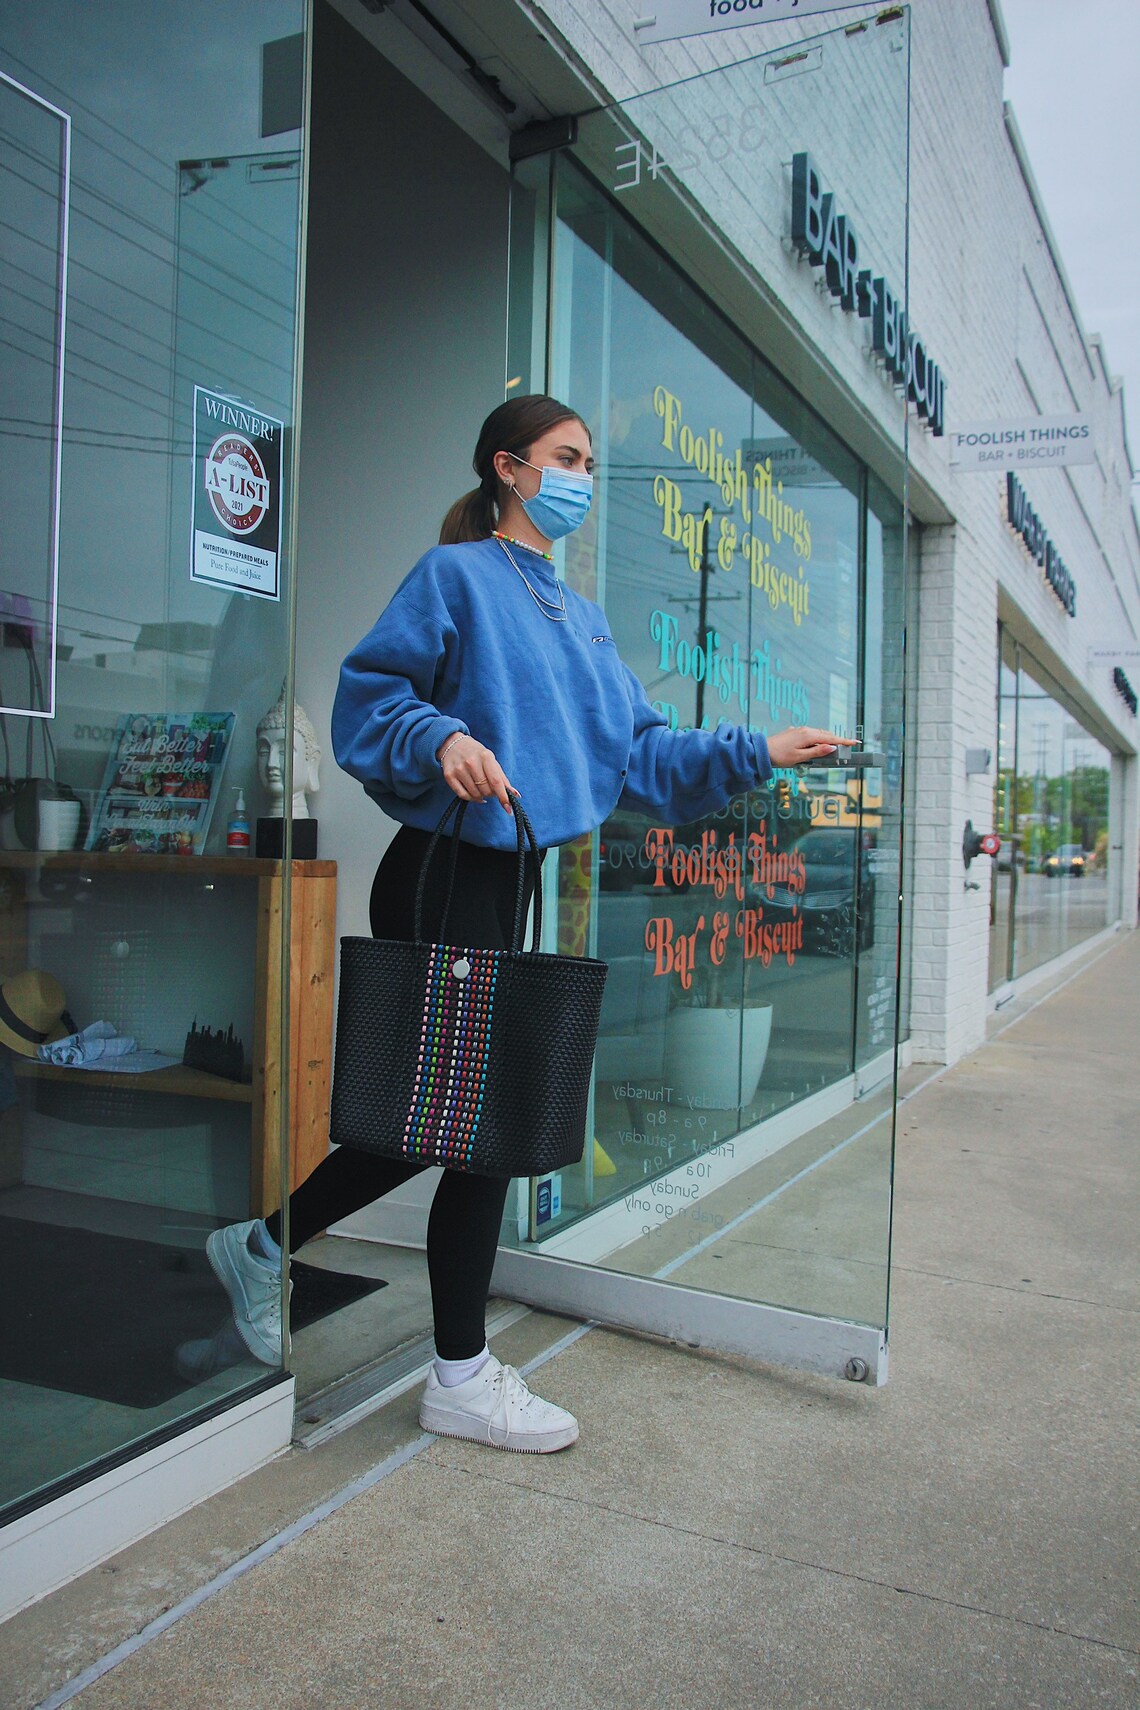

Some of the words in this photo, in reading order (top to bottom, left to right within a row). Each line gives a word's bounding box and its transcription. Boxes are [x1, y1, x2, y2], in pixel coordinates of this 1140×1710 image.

[792, 151, 860, 312] BAR
[204, 396, 274, 442] WINNER!
[957, 430, 1026, 447] FOOLISH
[1029, 425, 1089, 442] THINGS
[978, 449, 1004, 462] BAR
[1017, 445, 1066, 459] BISCUIT
[208, 467, 267, 503] A-LIST
[653, 385, 751, 524] Foolish
[753, 457, 812, 562] Things
[221, 507, 253, 527] CHOICE
[231, 500, 243, 512] 2021
[254, 556, 269, 567] MEALS
[653, 474, 713, 573] Bar
[717, 516, 737, 573] &
[742, 532, 810, 626] Biscuit
[210, 559, 223, 570] Pure
[225, 562, 239, 574] Food
[239, 568, 249, 577] and
[248, 569, 262, 580] Juice
[650, 609, 748, 715] Foolish
[752, 639, 810, 727] Things
[157, 754, 210, 774] Better
[645, 828, 745, 902] Foolish
[747, 819, 807, 899] Things
[645, 915, 705, 990] Bar
[709, 911, 730, 967] &
[735, 904, 804, 969] Biscuit
